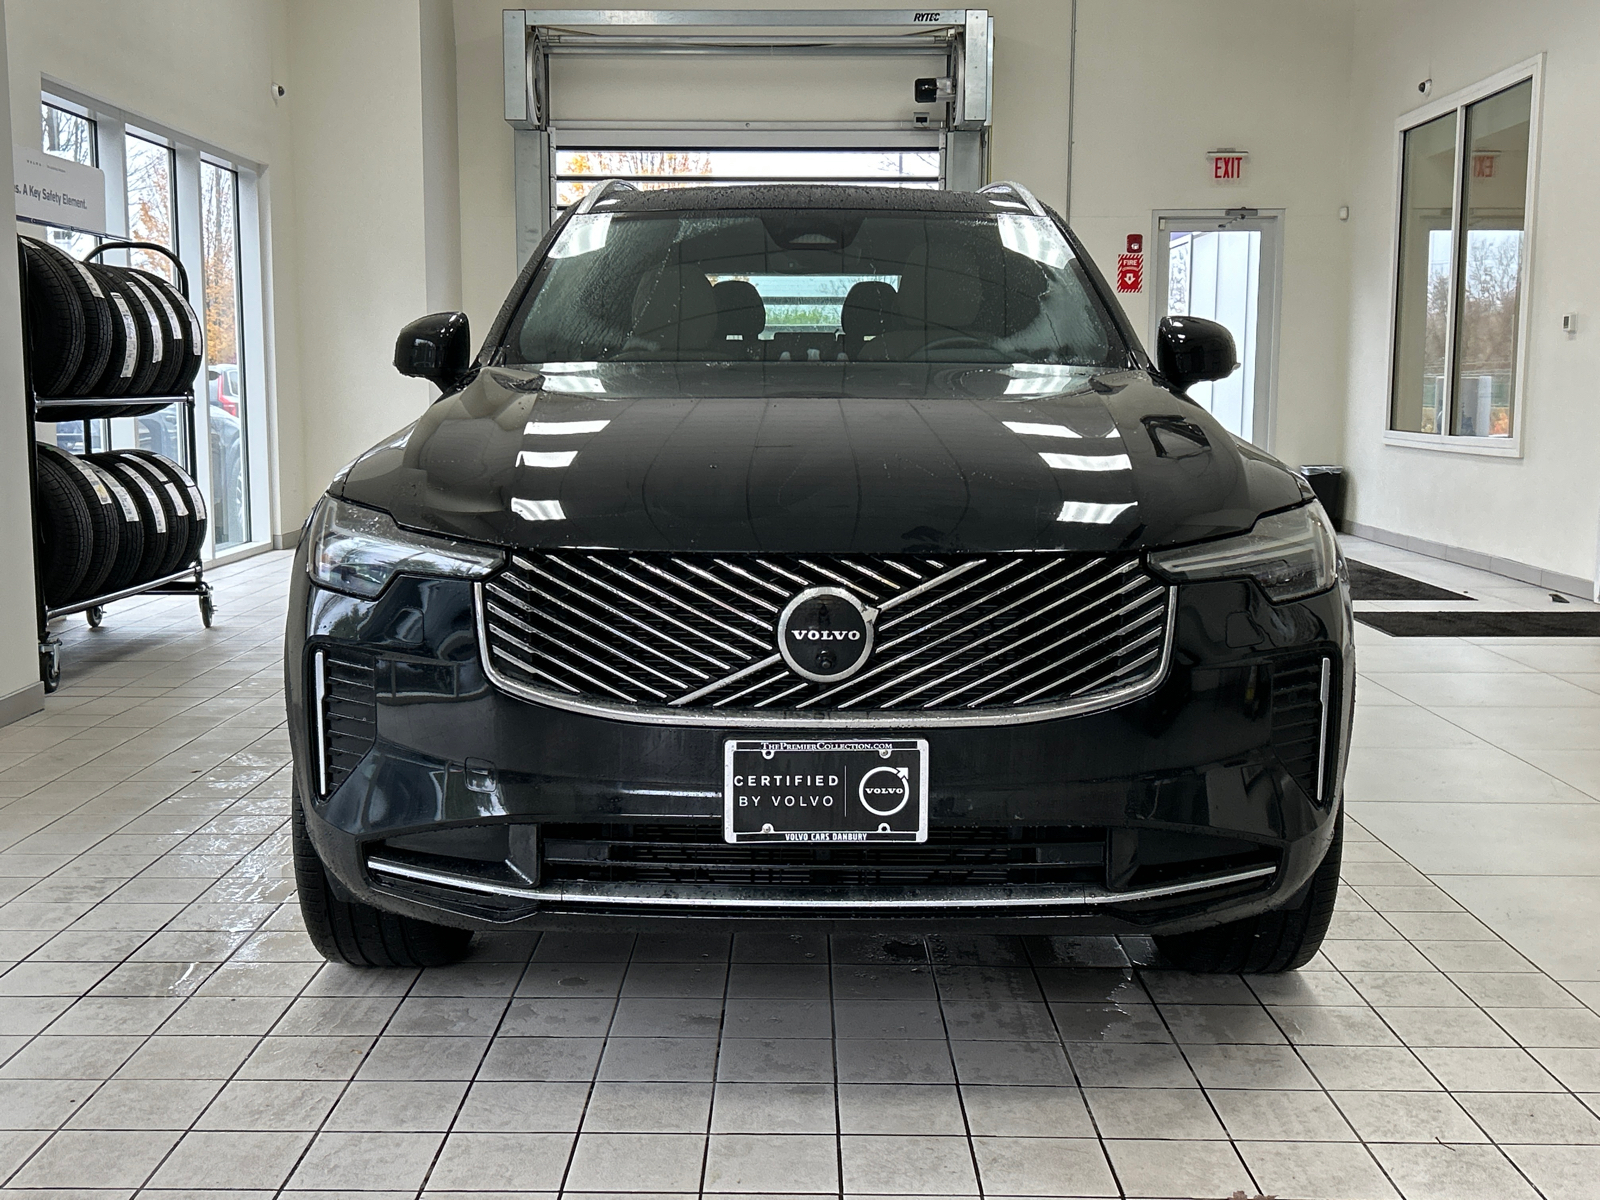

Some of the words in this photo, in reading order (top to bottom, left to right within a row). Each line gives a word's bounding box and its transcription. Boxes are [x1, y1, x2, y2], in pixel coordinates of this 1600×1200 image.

[913, 13, 940, 22] RYTEC
[1214, 157, 1243, 179] EXIT
[22, 183, 29, 196] A
[29, 185, 42, 201] Key
[42, 188, 62, 206] Safety
[62, 193, 88, 210] Element.
[791, 629, 861, 641] VOLVO
[733, 775, 839, 787] CERTIFIED
[864, 787, 904, 795] VOLVO
[738, 795, 761, 807] BY
[771, 795, 834, 807] VOLVO
[785, 833, 808, 841] VOLVO
[811, 833, 830, 841] CARS
[832, 833, 868, 841] DANBURY
